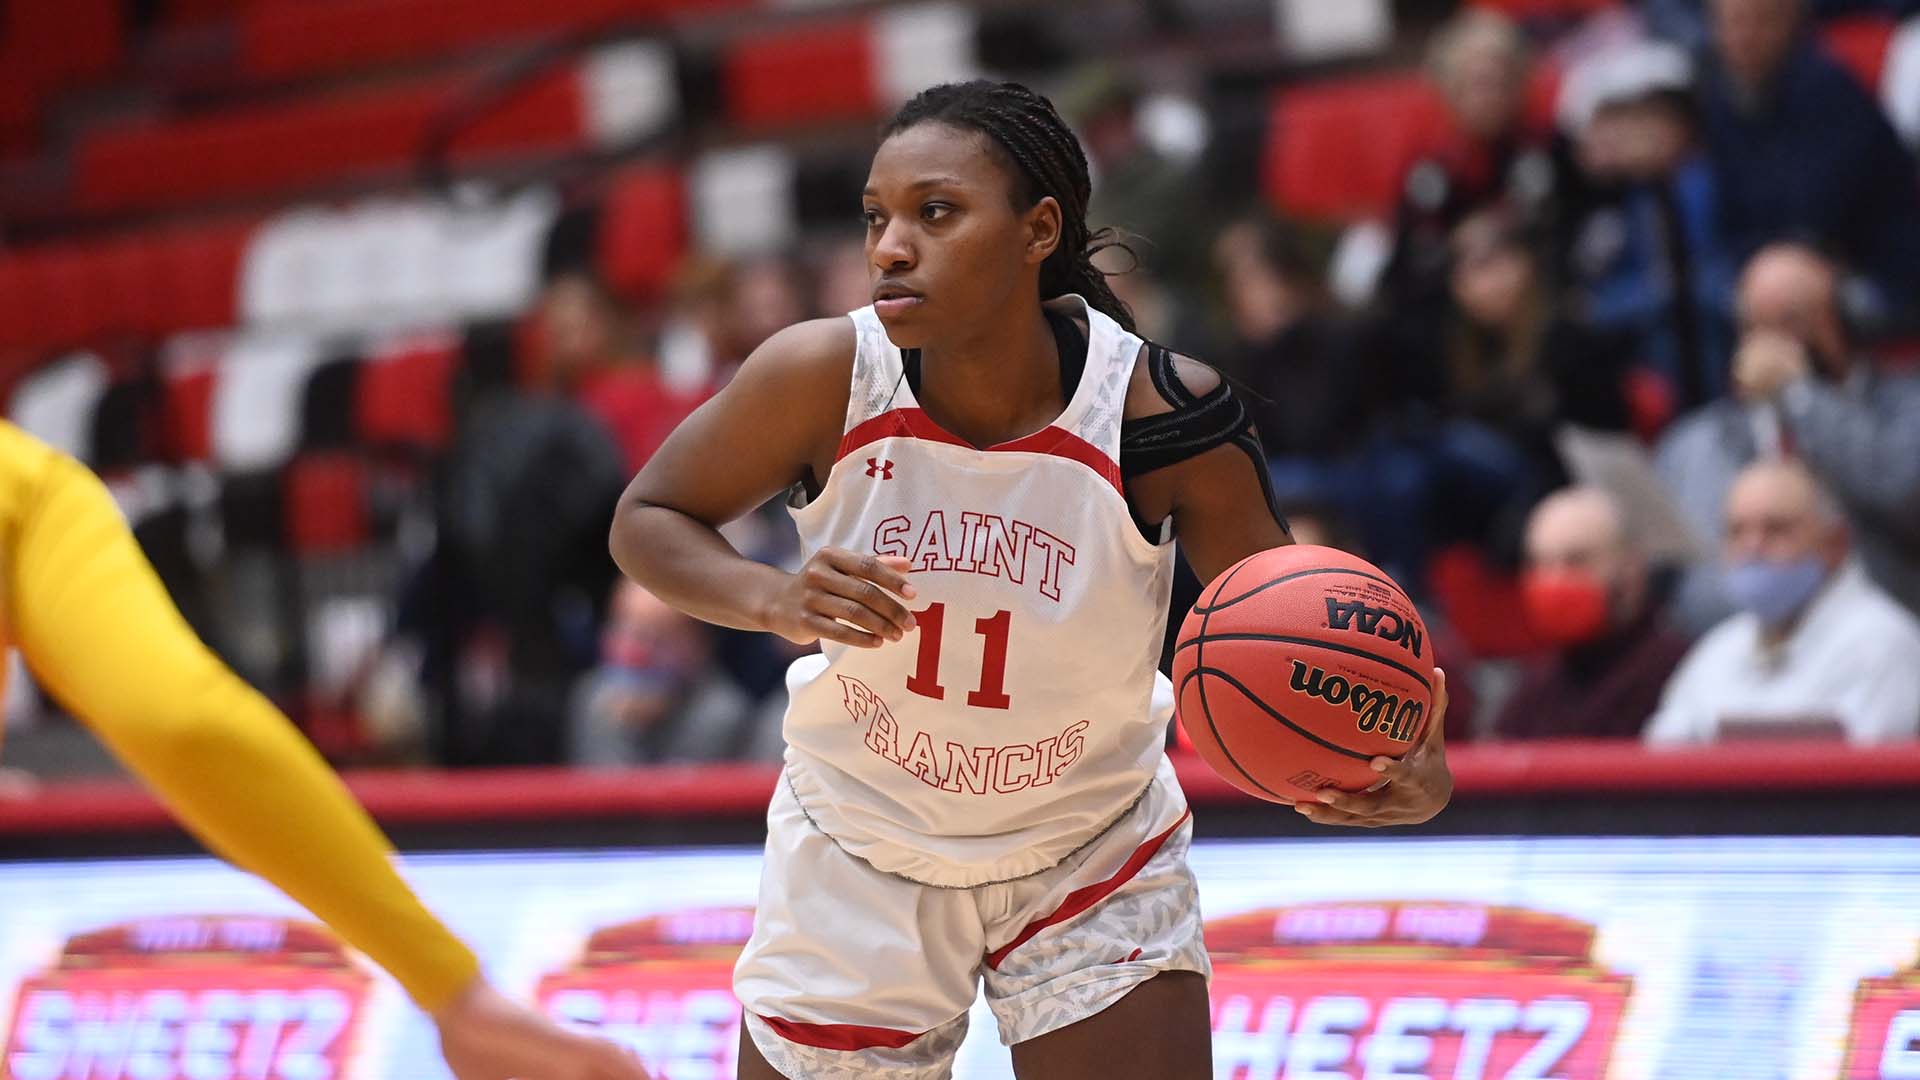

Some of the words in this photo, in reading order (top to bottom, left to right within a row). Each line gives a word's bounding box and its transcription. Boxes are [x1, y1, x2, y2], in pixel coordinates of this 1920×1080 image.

[873, 510, 1076, 602] SAINT
[906, 602, 1011, 710] 11
[1325, 597, 1422, 659] NCAA
[837, 674, 1089, 795] FRANCIS
[1289, 658, 1423, 743] Wilson
[8, 987, 350, 1080] SHEETZ
[1212, 994, 1591, 1080] HEETZ
